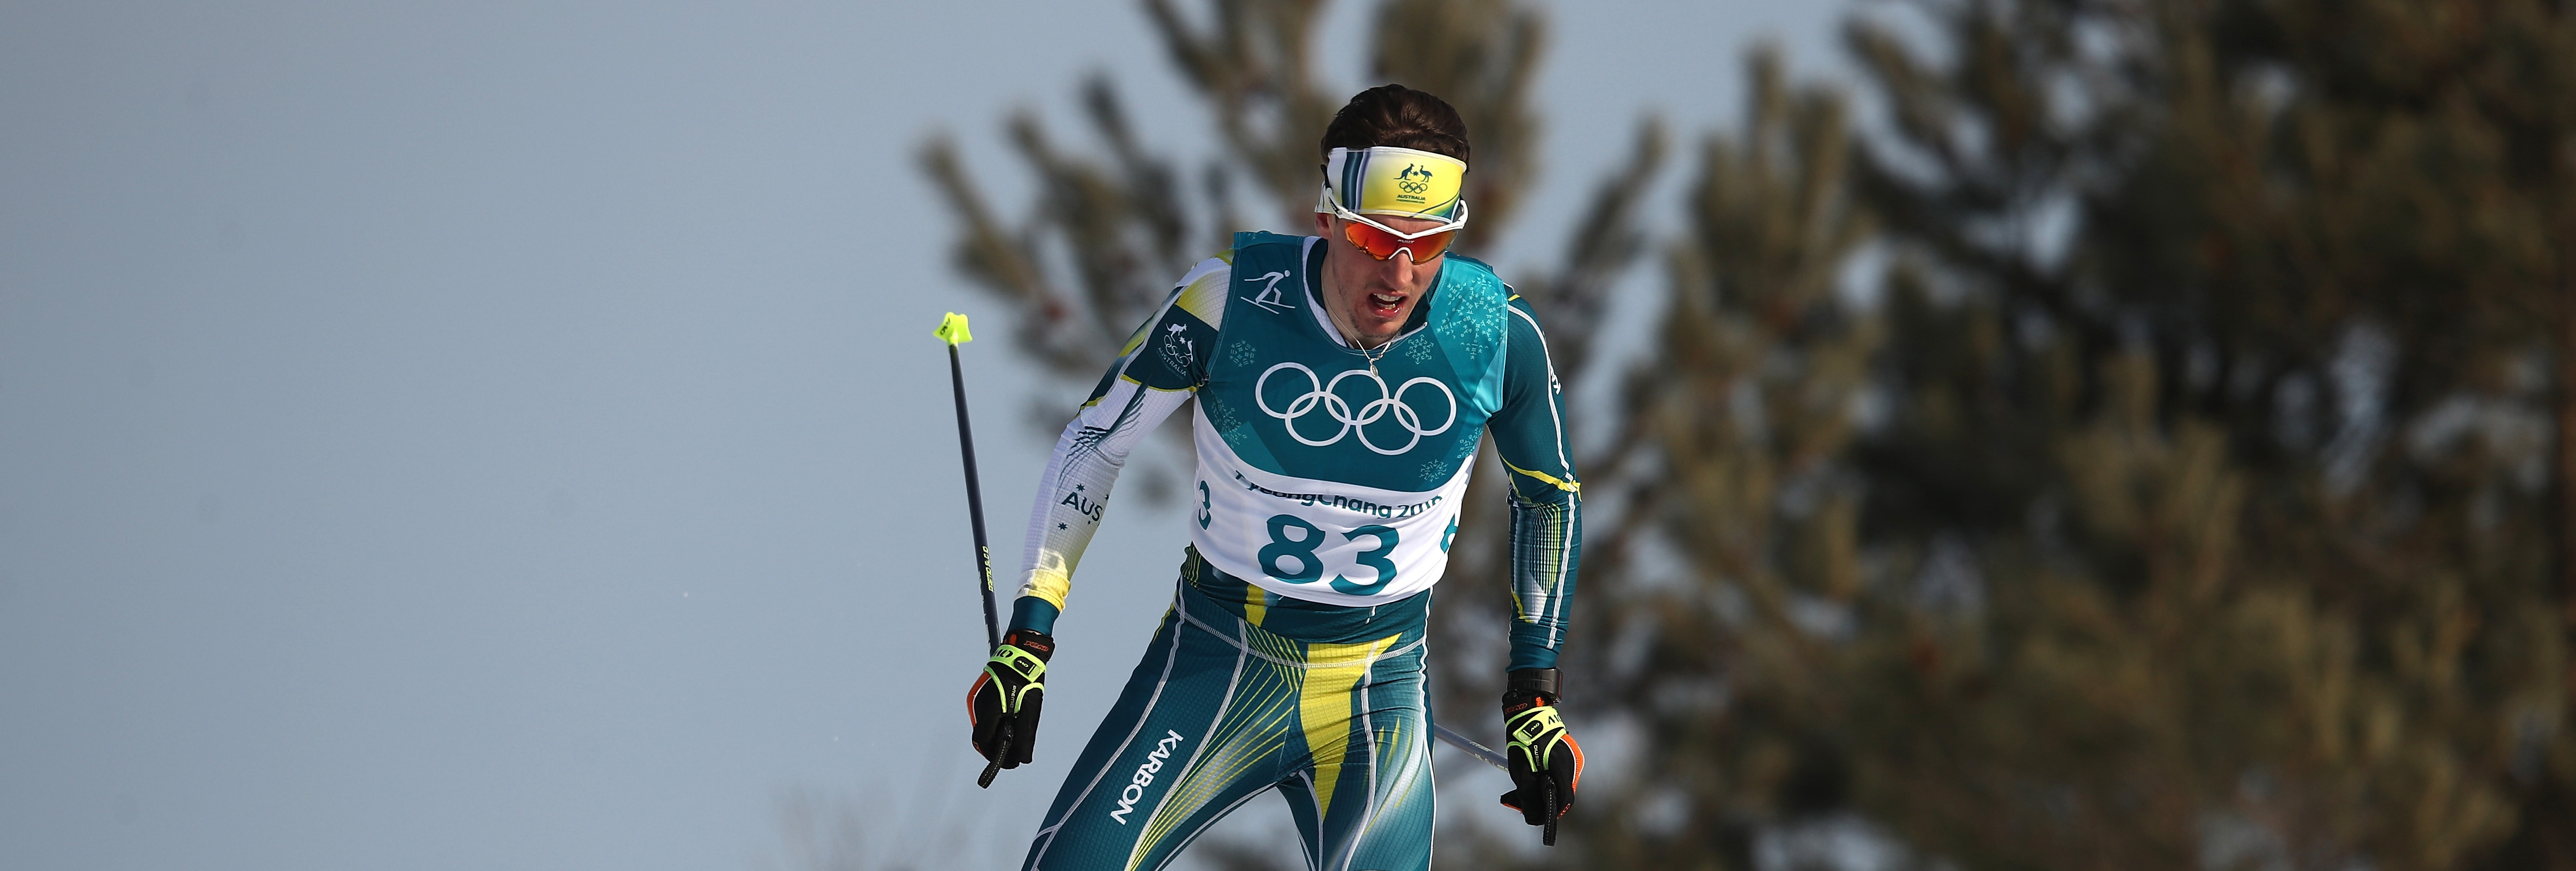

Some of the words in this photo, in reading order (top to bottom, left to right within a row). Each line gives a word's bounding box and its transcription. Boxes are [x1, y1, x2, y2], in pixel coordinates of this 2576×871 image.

[1158, 347, 1187, 376] AUSTRALIA
[1061, 492, 1103, 522] AUS
[1257, 514, 1400, 596] 83
[1110, 729, 1184, 825] KARBON
